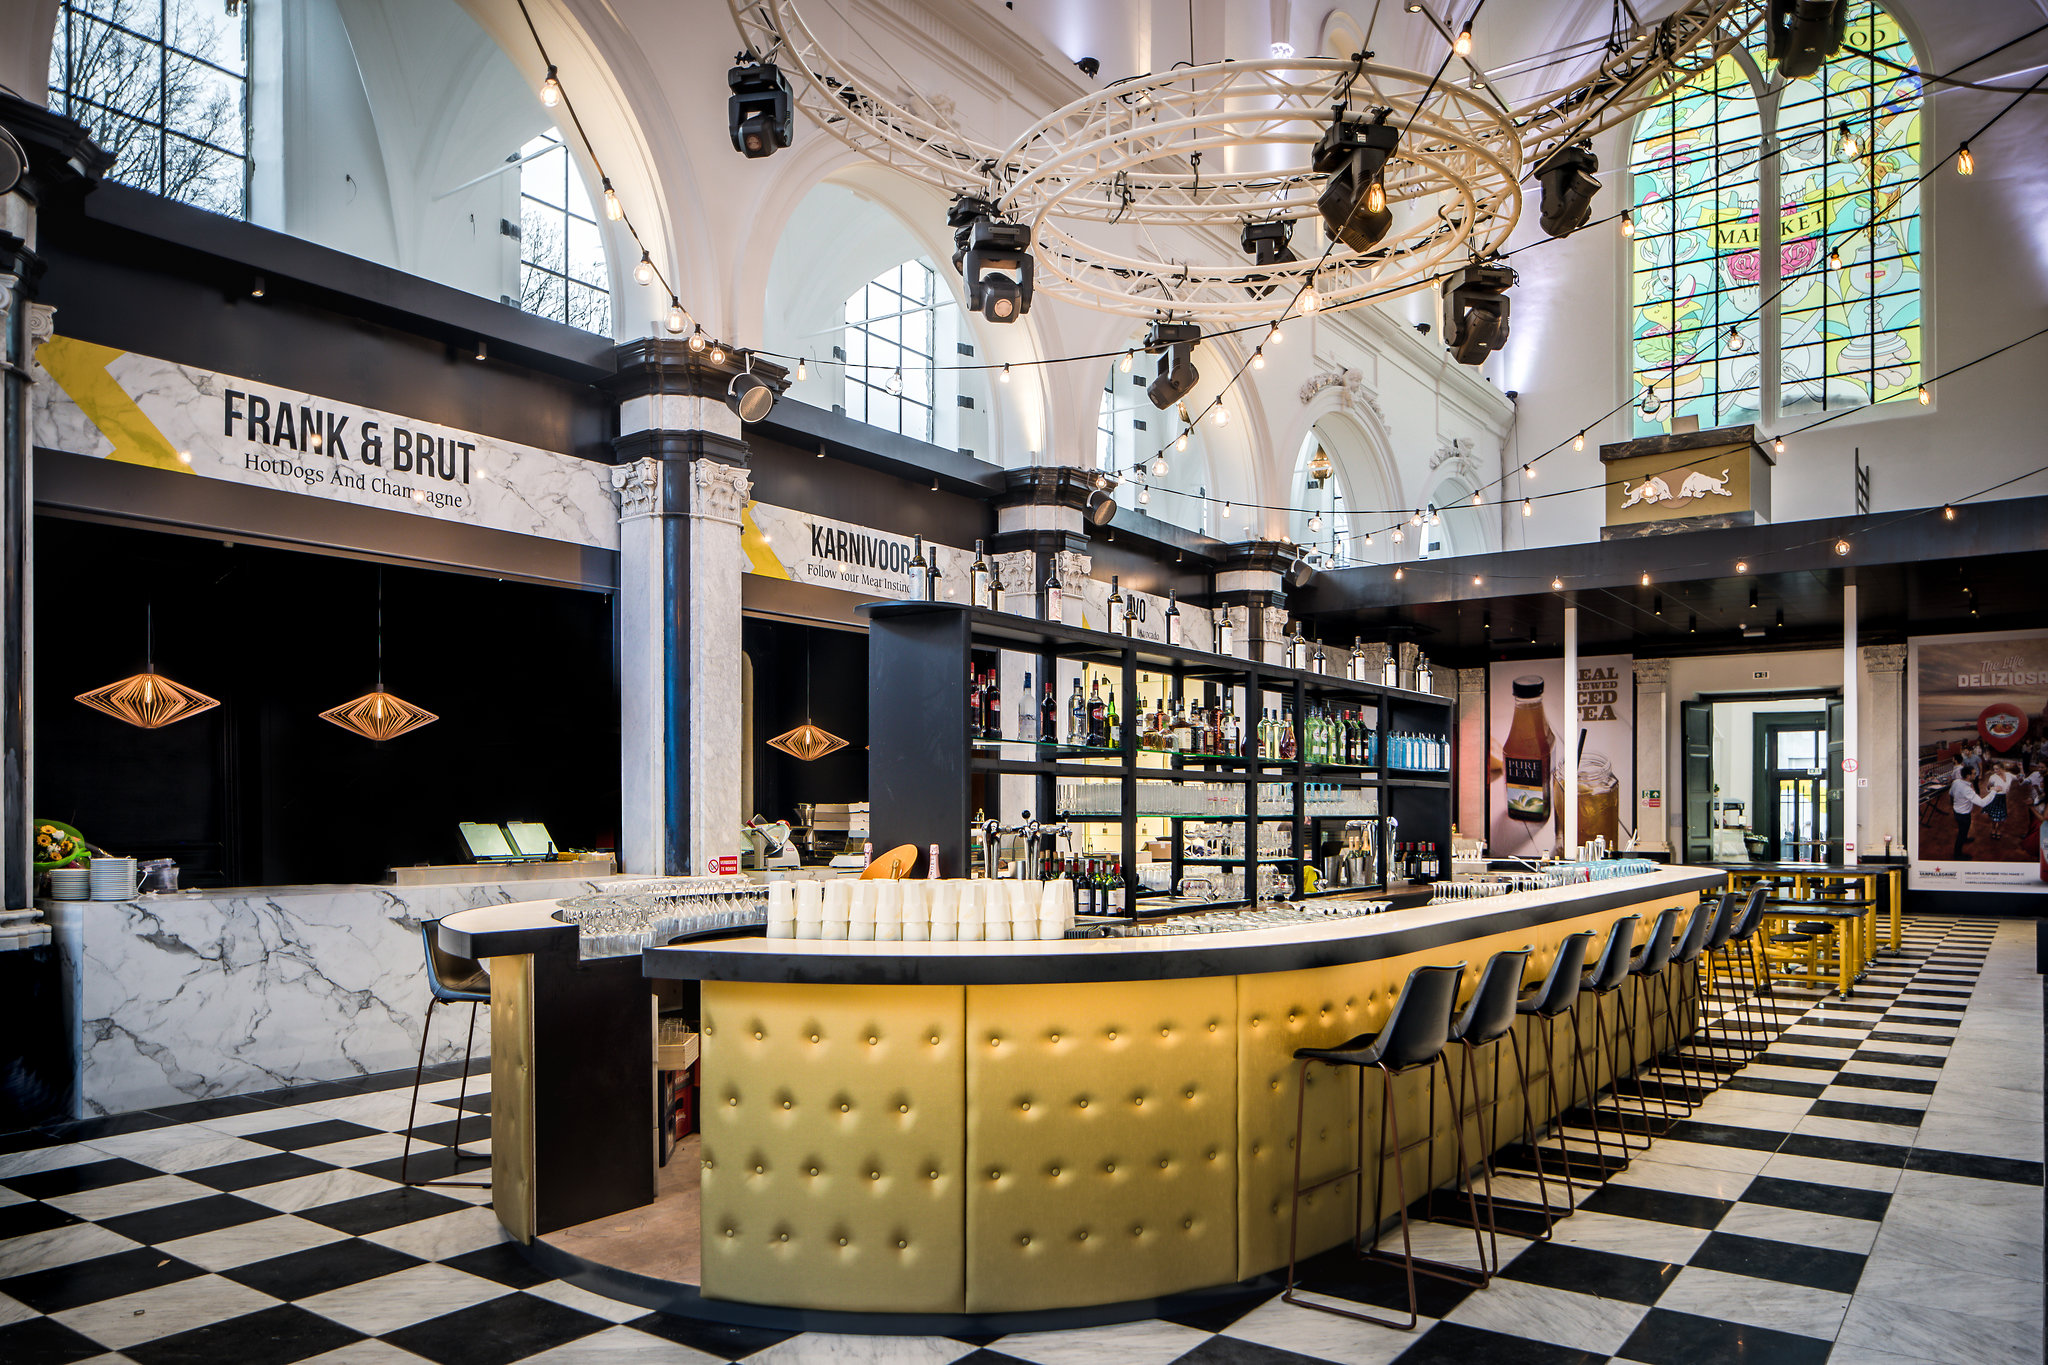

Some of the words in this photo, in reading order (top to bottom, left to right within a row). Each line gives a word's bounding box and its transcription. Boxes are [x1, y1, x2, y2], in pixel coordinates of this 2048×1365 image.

[1850, 30, 1885, 47] OD
[224, 388, 350, 461] FRANK
[361, 421, 383, 467] &
[393, 427, 476, 485] BRUT
[244, 453, 325, 485] HotDogs
[330, 470, 365, 490] And
[371, 477, 463, 508] Chamagne
[812, 523, 911, 576] KARNIVOOR
[807, 563, 837, 579] Follow
[840, 571, 860, 583] Your
[861, 573, 882, 588] Meat
[884, 578, 911, 593] Instinc
[1131, 596, 1146, 623] VO
[1577, 667, 1619, 681] EAL
[1577, 681, 1618, 690] REWED
[1577, 690, 1618, 705] CED
